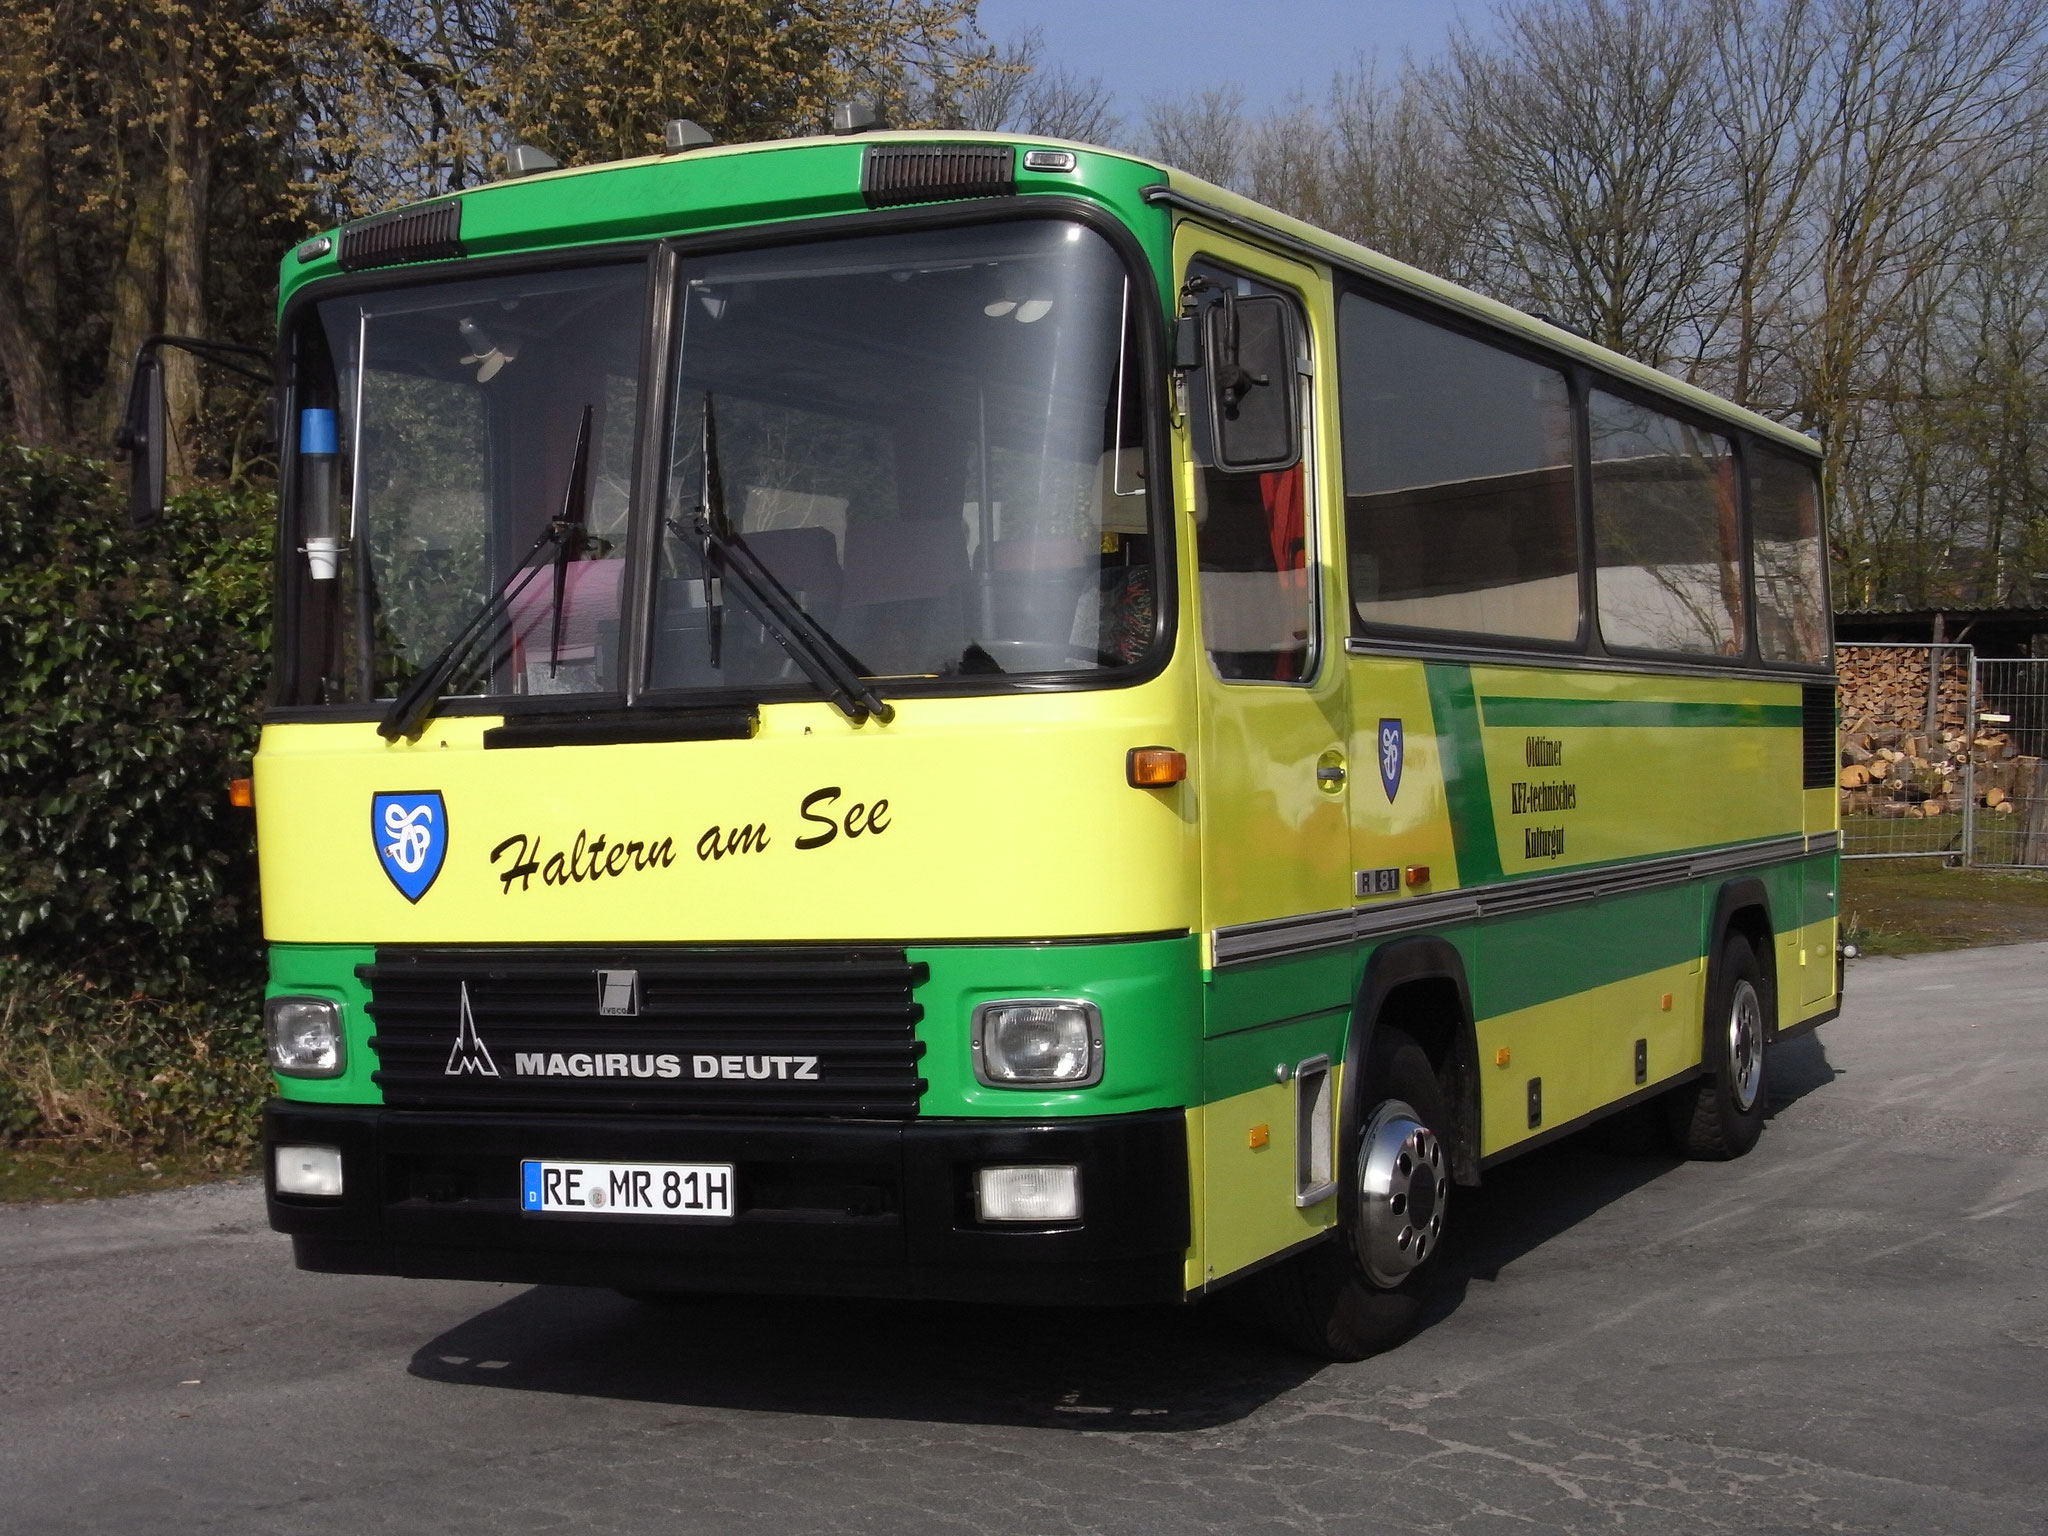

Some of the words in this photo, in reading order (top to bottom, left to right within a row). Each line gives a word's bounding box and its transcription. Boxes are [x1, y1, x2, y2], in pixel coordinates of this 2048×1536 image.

[1525, 736, 1562, 767] Oldtimer
[1511, 780, 1576, 814] KFZ-technisches
[489, 828, 676, 895] Haltern
[696, 819, 770, 861] am
[794, 786, 892, 850] See
[1525, 825, 1565, 860] Kulturgut
[1380, 870, 1396, 890] 81
[515, 1053, 681, 1078] MAGIRUS
[693, 1055, 819, 1080] DEUTZ
[529, 1191, 537, 1202] D
[543, 1168, 585, 1206] RE
[609, 1170, 653, 1208] MR
[662, 1170, 727, 1209] 81H
